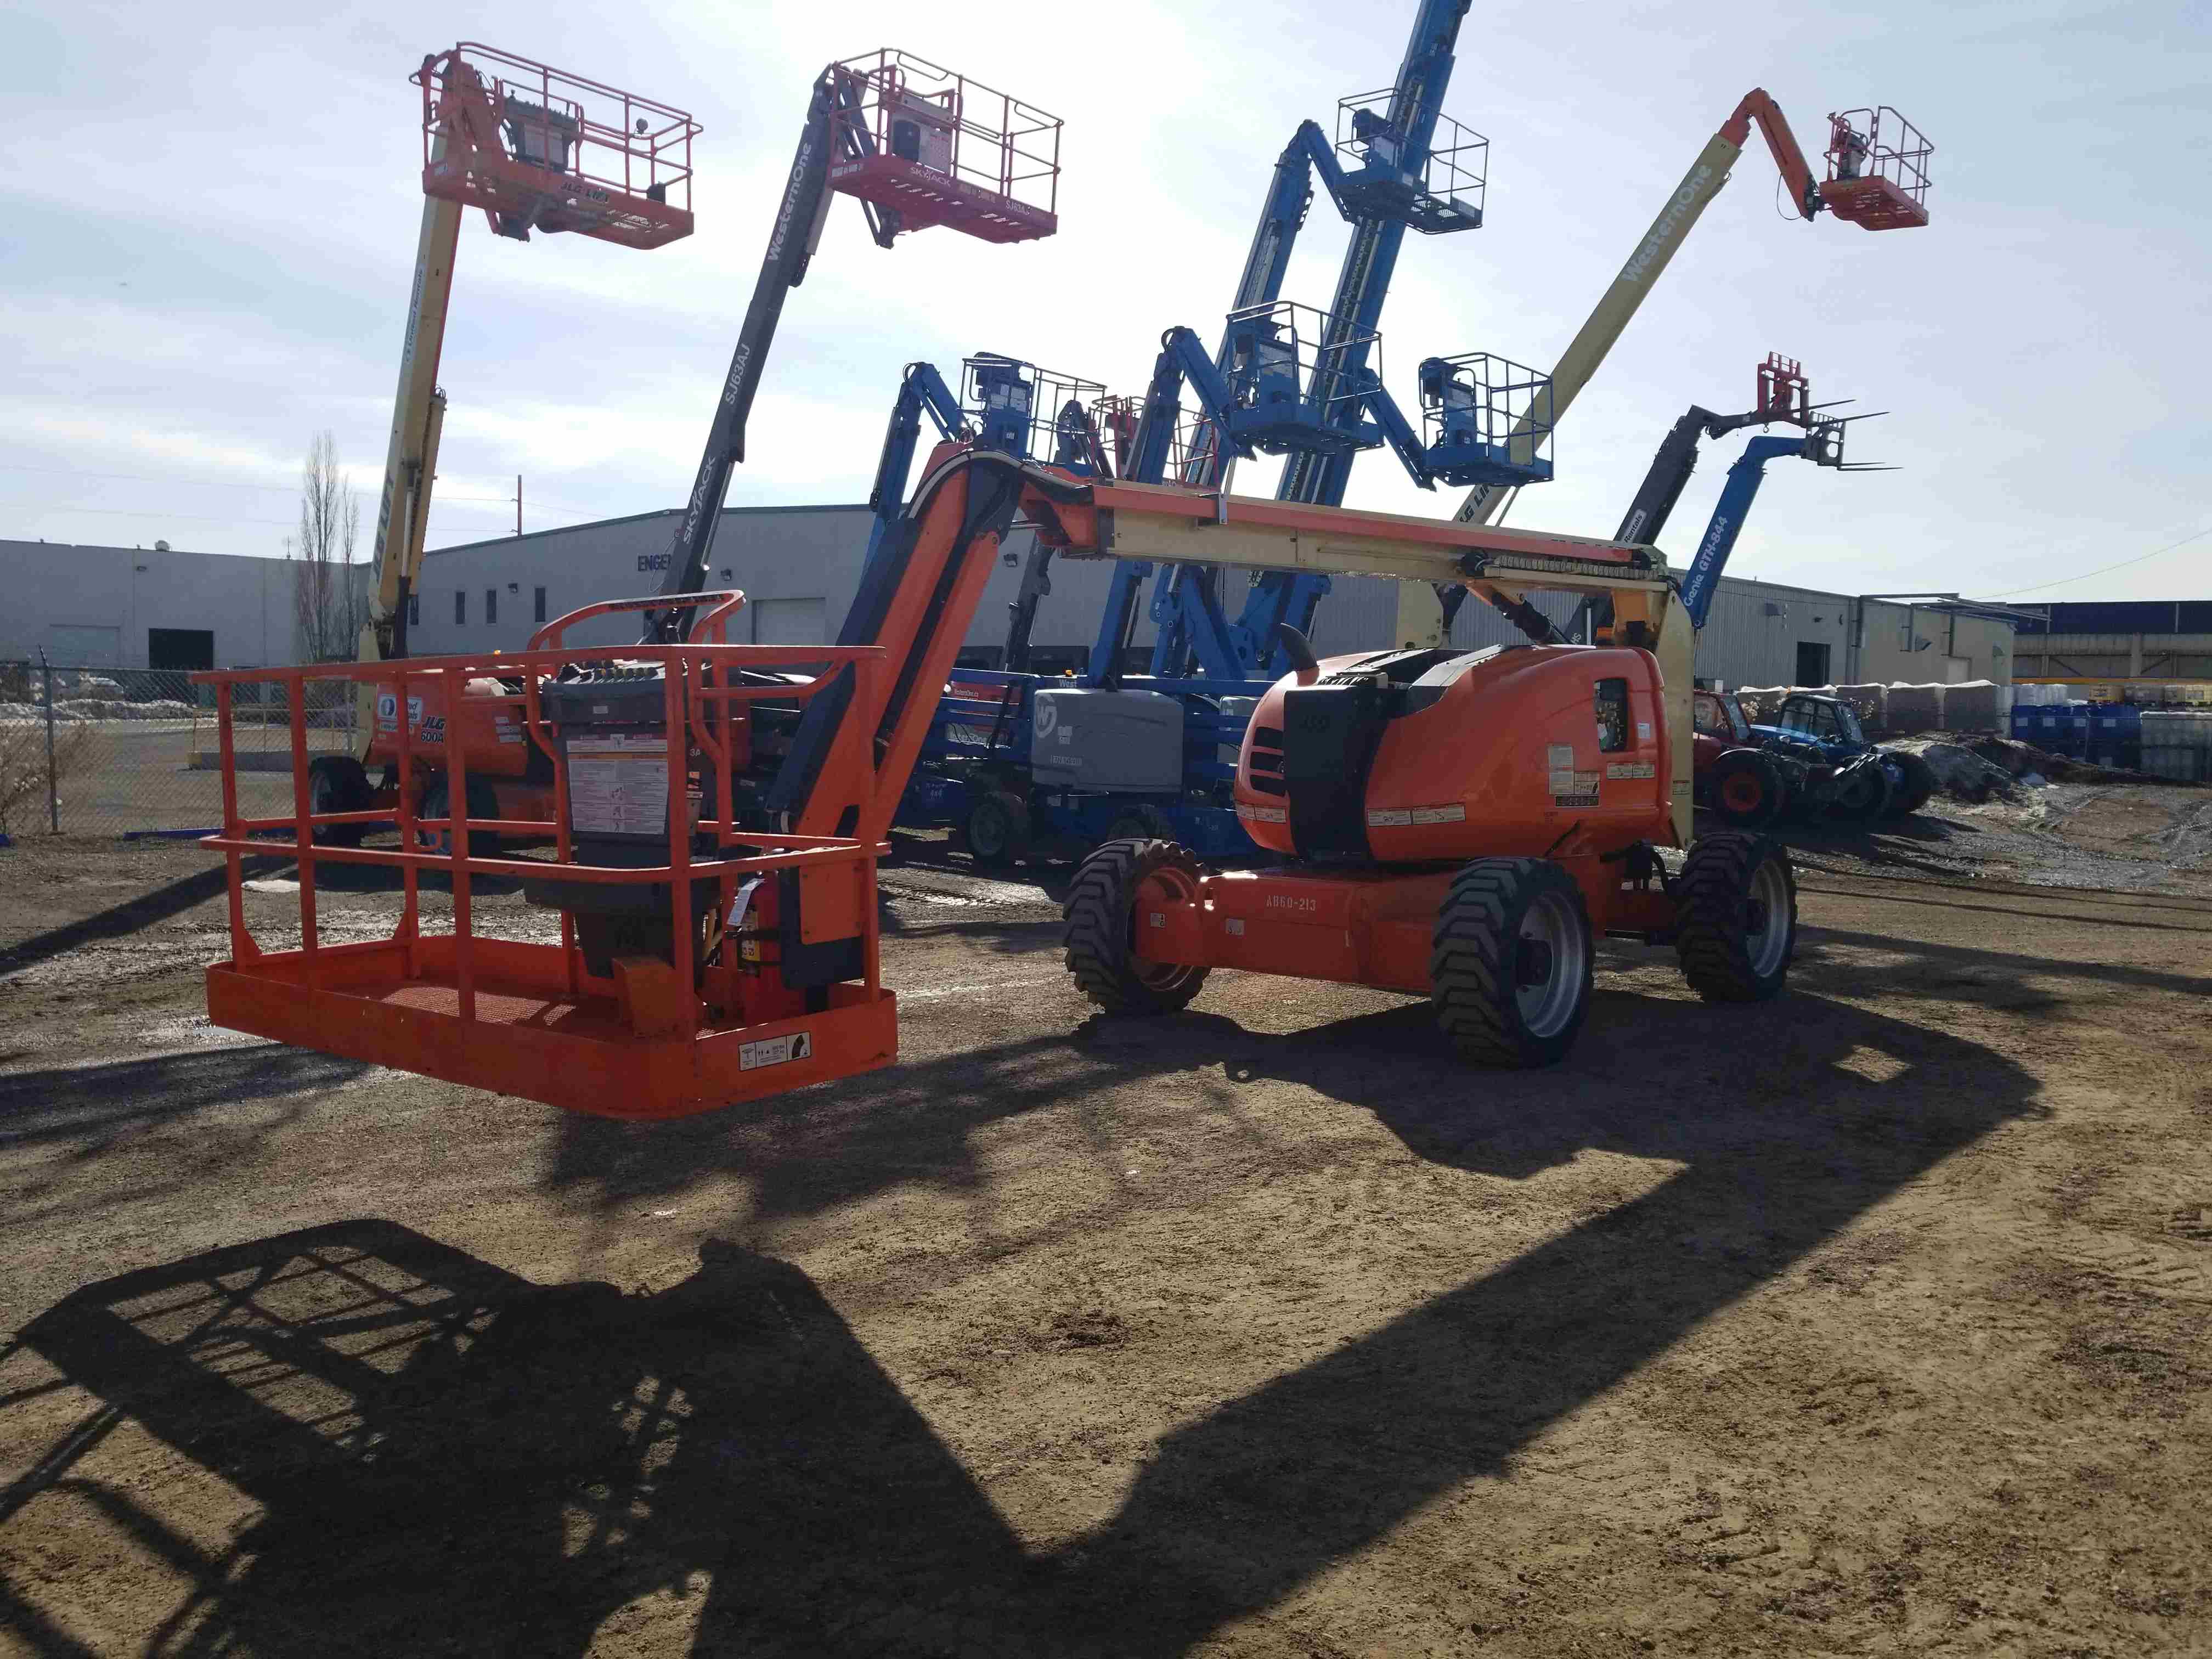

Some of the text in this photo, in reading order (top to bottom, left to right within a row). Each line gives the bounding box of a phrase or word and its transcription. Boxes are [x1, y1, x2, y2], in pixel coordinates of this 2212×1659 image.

[910, 166, 951, 188] SKYJACK
[768, 143, 812, 261] WesternOne
[1622, 166, 1712, 281] WesternOne
[725, 343, 750, 404] SJ63AJ
[683, 456, 715, 544] SKYJACK
[1624, 514, 1643, 543] Rentals
[1683, 516, 1728, 607] Genie GTH-844
[1058, 679, 1077, 688] West
[422, 715, 447, 730] JLG
[1266, 895, 1316, 911] AB60-213
